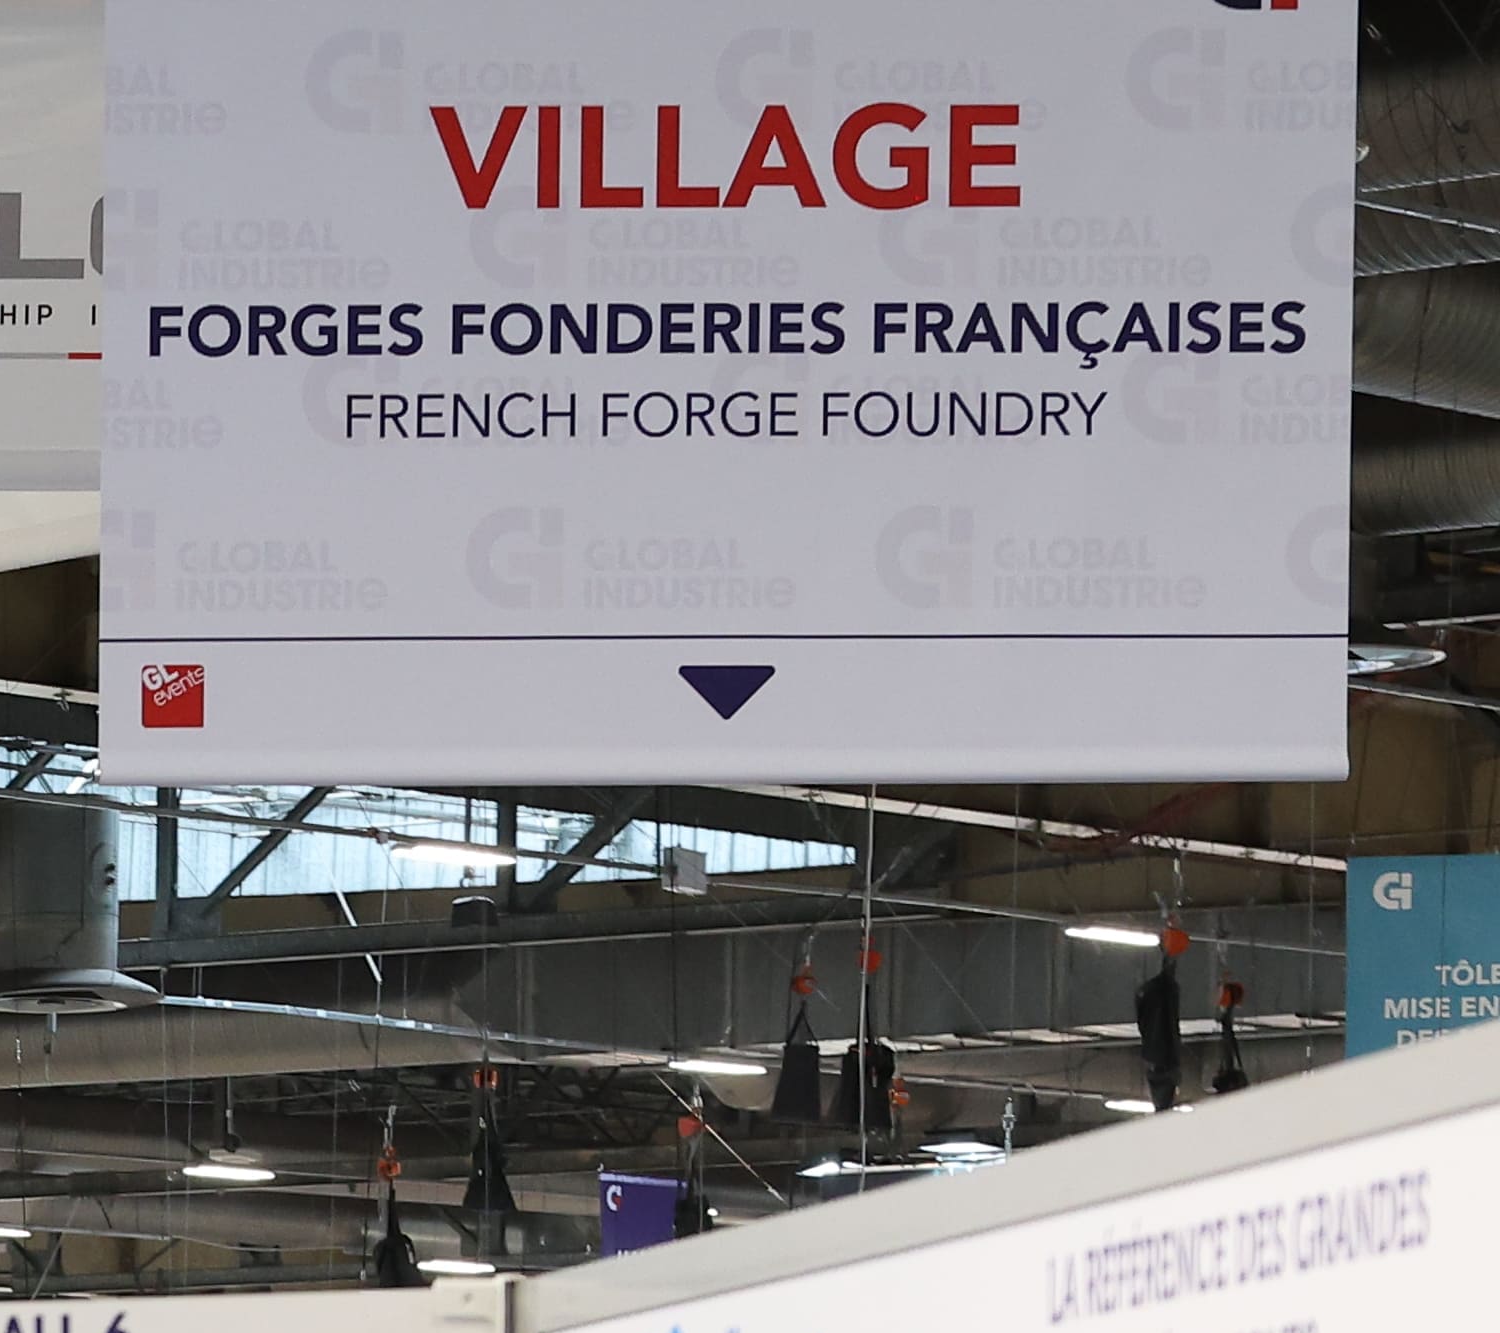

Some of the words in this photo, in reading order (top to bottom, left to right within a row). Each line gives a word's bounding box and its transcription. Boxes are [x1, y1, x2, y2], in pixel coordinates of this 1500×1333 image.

[430, 103, 1021, 209] VILLAGE
[149, 303, 424, 359] FORGES
[450, 301, 845, 356] FONDERIES
[873, 300, 1306, 369] FRANÇAISES
[345, 393, 575, 439] FRENCH
[602, 392, 799, 438] FORGE
[821, 391, 1107, 436] FOUNDRY
[142, 664, 179, 691] GL
[153, 668, 204, 706] events
[1384, 998, 1452, 1018] MISE
[1461, 996, 1500, 1018] EN
[1047, 1260, 1080, 1324] LA
[1238, 1208, 1285, 1282] DES
[1295, 1172, 1431, 1272] GRANDES
